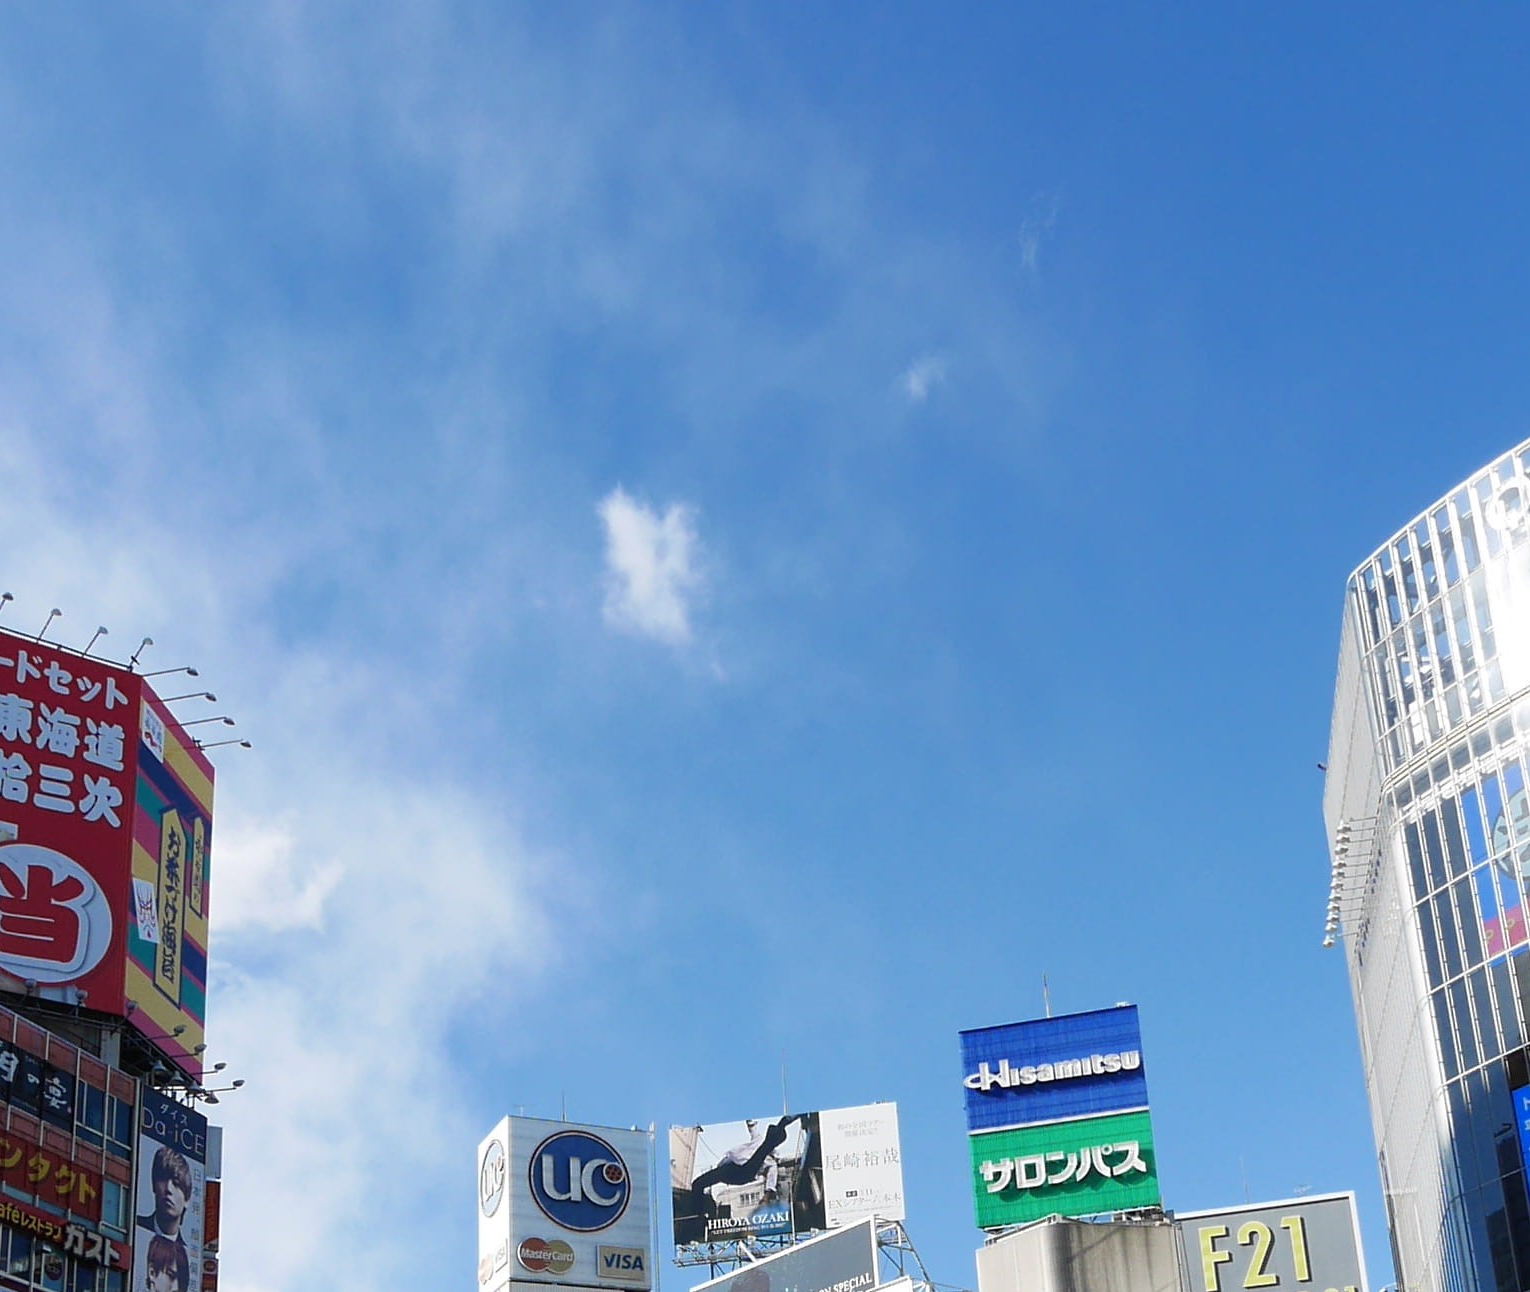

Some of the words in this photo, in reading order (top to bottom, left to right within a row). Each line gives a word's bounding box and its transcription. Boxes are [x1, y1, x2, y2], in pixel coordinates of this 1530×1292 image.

[963, 1048, 1141, 1093] Hisamitsu
[980, 1140, 1148, 1193] サロンパス
[707, 1216, 751, 1230] HIROYA
[752, 1210, 790, 1226] OZAKI
[63, 1225, 120, 1267] ガスト
[520, 1247, 574, 1263] MasterCard
[603, 1252, 646, 1272] VISA
